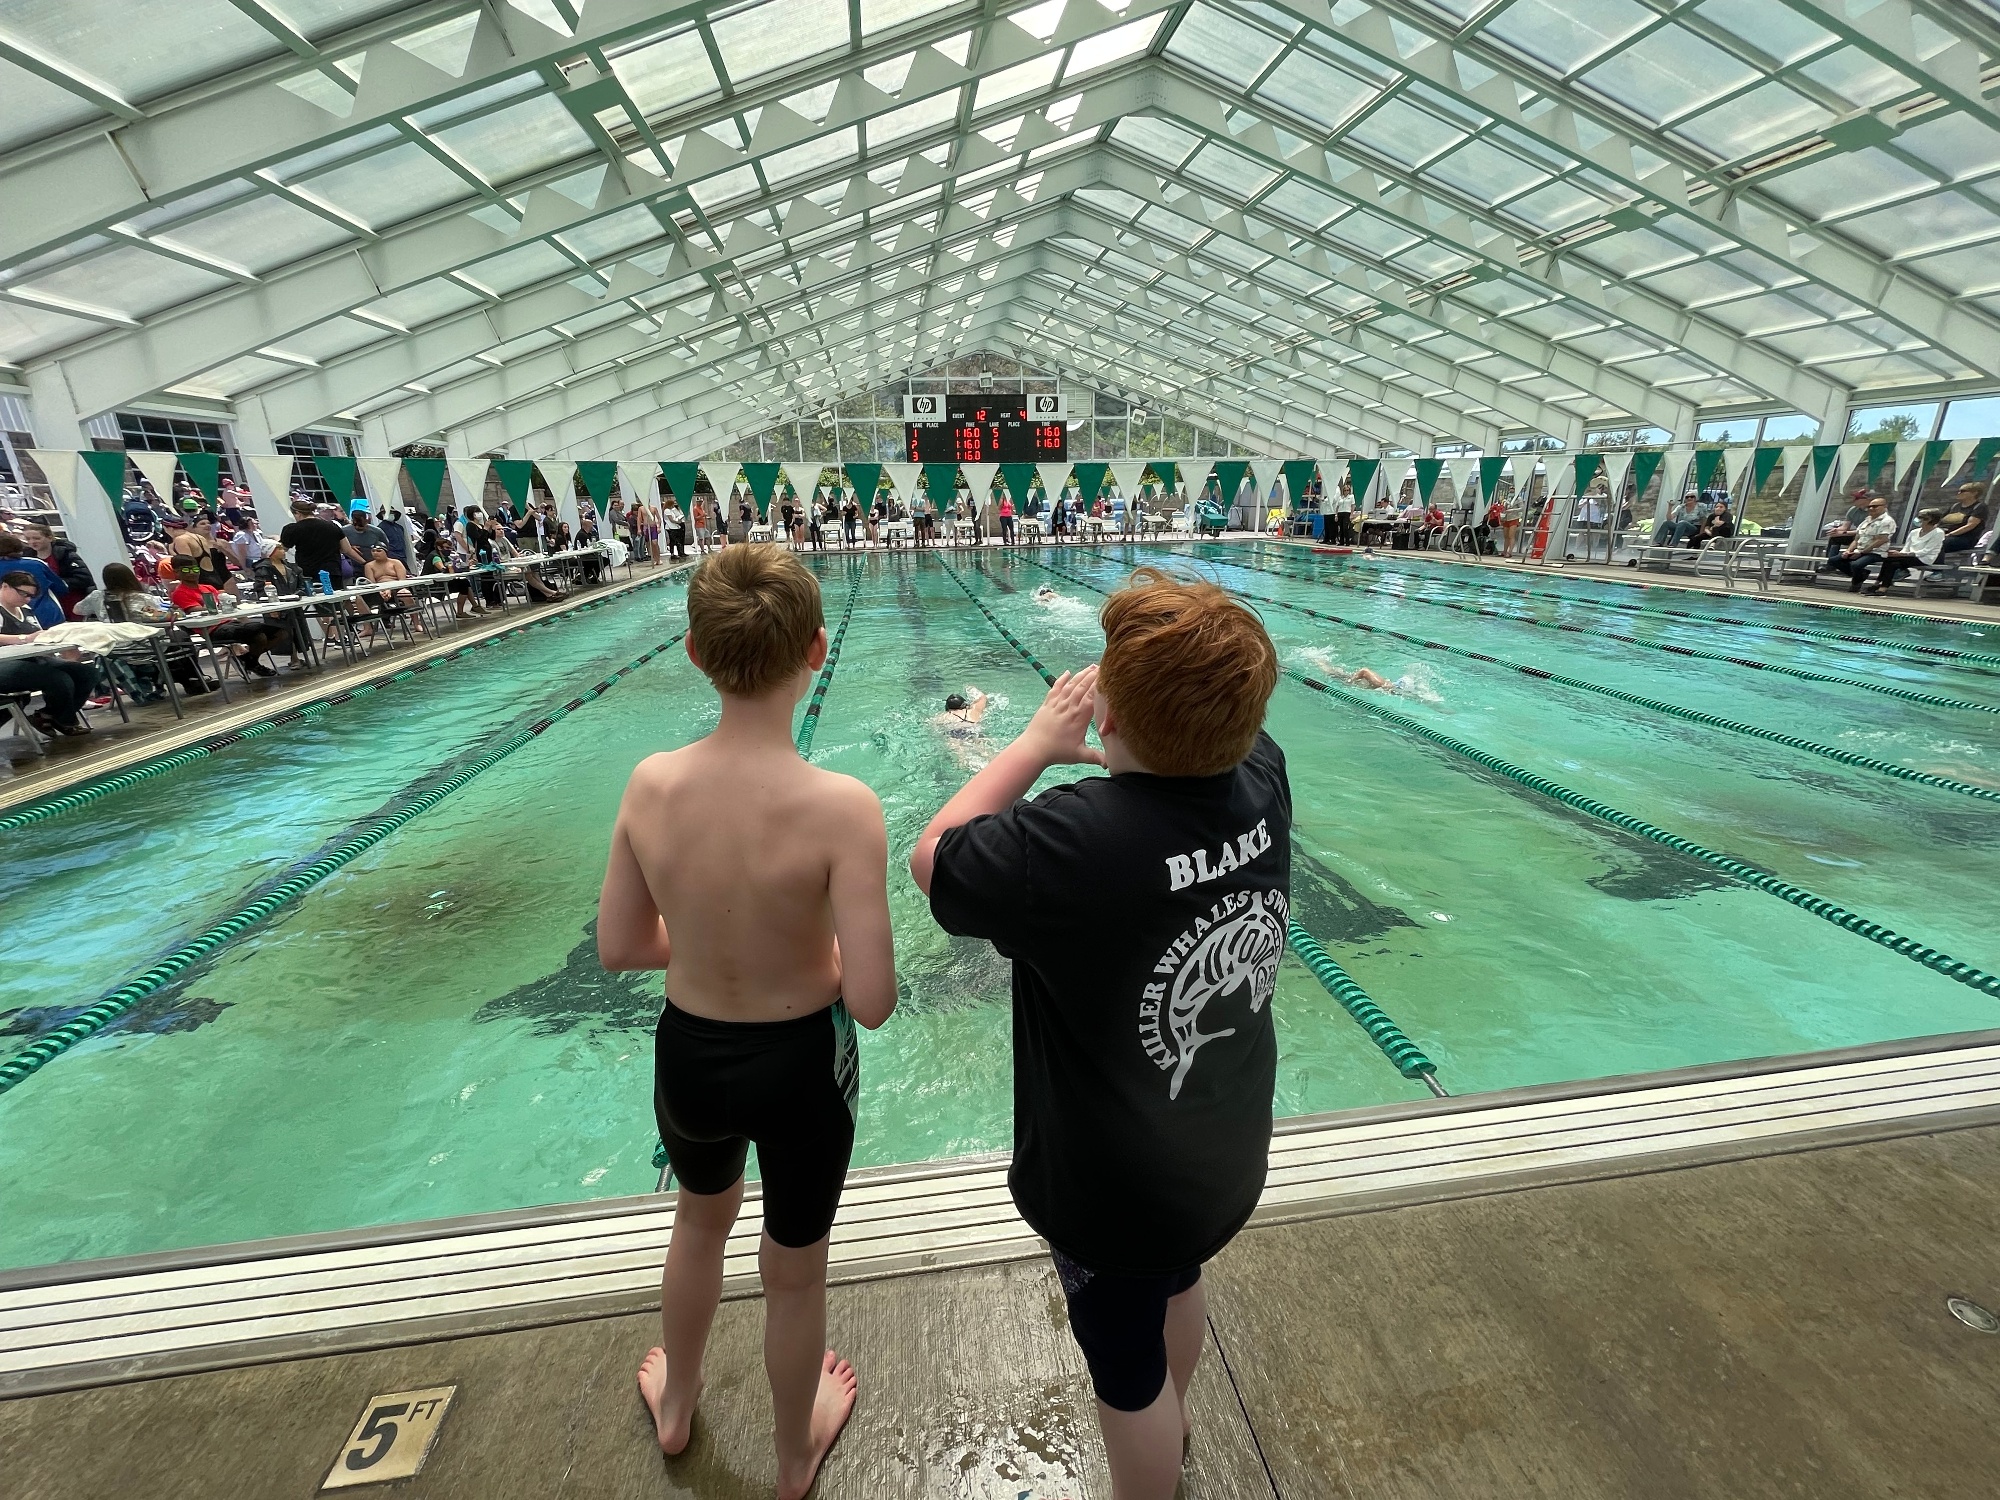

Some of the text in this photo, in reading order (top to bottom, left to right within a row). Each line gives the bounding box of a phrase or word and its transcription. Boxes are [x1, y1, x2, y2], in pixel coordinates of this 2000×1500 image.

[918, 397, 931, 413] hp
[1041, 397, 1053, 412] hp
[976, 410, 986, 420] 12
[1019, 410, 1026, 420] 4
[992, 427, 999, 438] 5
[992, 439, 999, 449] 6
[912, 451, 919, 461] 3
[1165, 817, 1272, 891] BLAKE
[1153, 889, 1250, 974] WHALES
[1138, 981, 1179, 1071] KILLER
[345, 1397, 444, 1471] 5 FT
